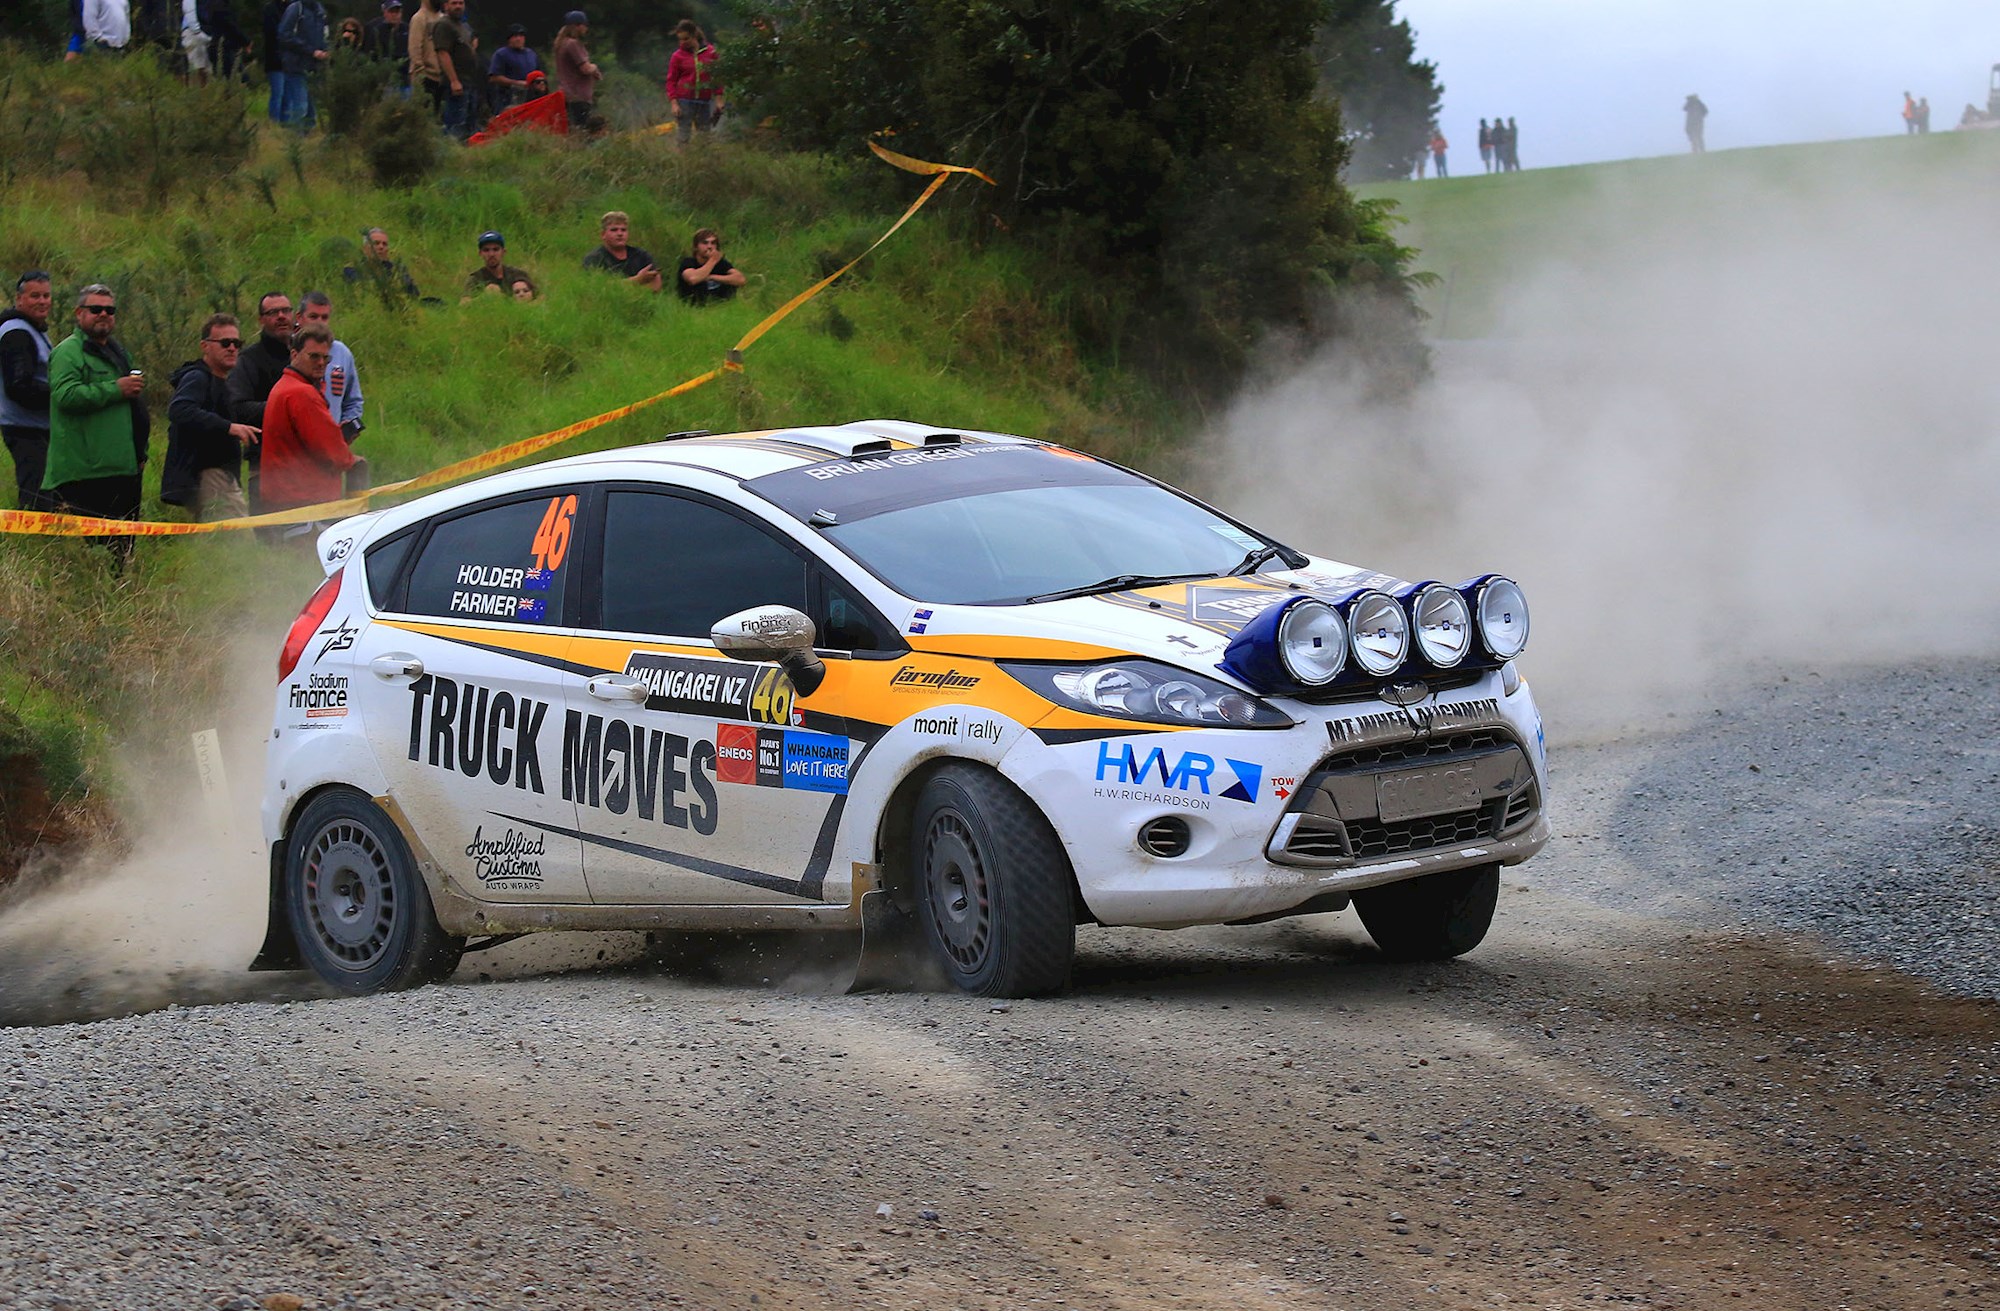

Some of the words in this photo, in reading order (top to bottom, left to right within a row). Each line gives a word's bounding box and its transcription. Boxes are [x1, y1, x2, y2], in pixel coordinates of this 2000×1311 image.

[804, 458, 893, 481] BRIAN
[888, 448, 977, 467] GREEN
[531, 494, 577, 572] 46
[456, 564, 524, 589] HOLDER
[450, 591, 517, 617] FARMER
[308, 673, 348, 689] Stadium
[721, 676, 747, 705] NZ
[289, 684, 348, 708] Finance
[751, 667, 794, 725] 46
[914, 716, 958, 735] monit
[968, 720, 1003, 744] rally
[1354, 710, 1412, 730] WHEE
[407, 673, 549, 795] TRUCK
[562, 708, 719, 836] MOVES
[718, 746, 753, 761] ENEOS
[785, 759, 808, 776] LOVE
[810, 760, 823, 777] IT
[822, 763, 849, 779] HERE!
[1095, 741, 1216, 795] HWR
[1271, 777, 1295, 786] TOW
[465, 825, 546, 860] Amplified
[473, 855, 542, 880] Customs
[485, 882, 508, 890] AUTO
[510, 882, 541, 890] WRAPS
